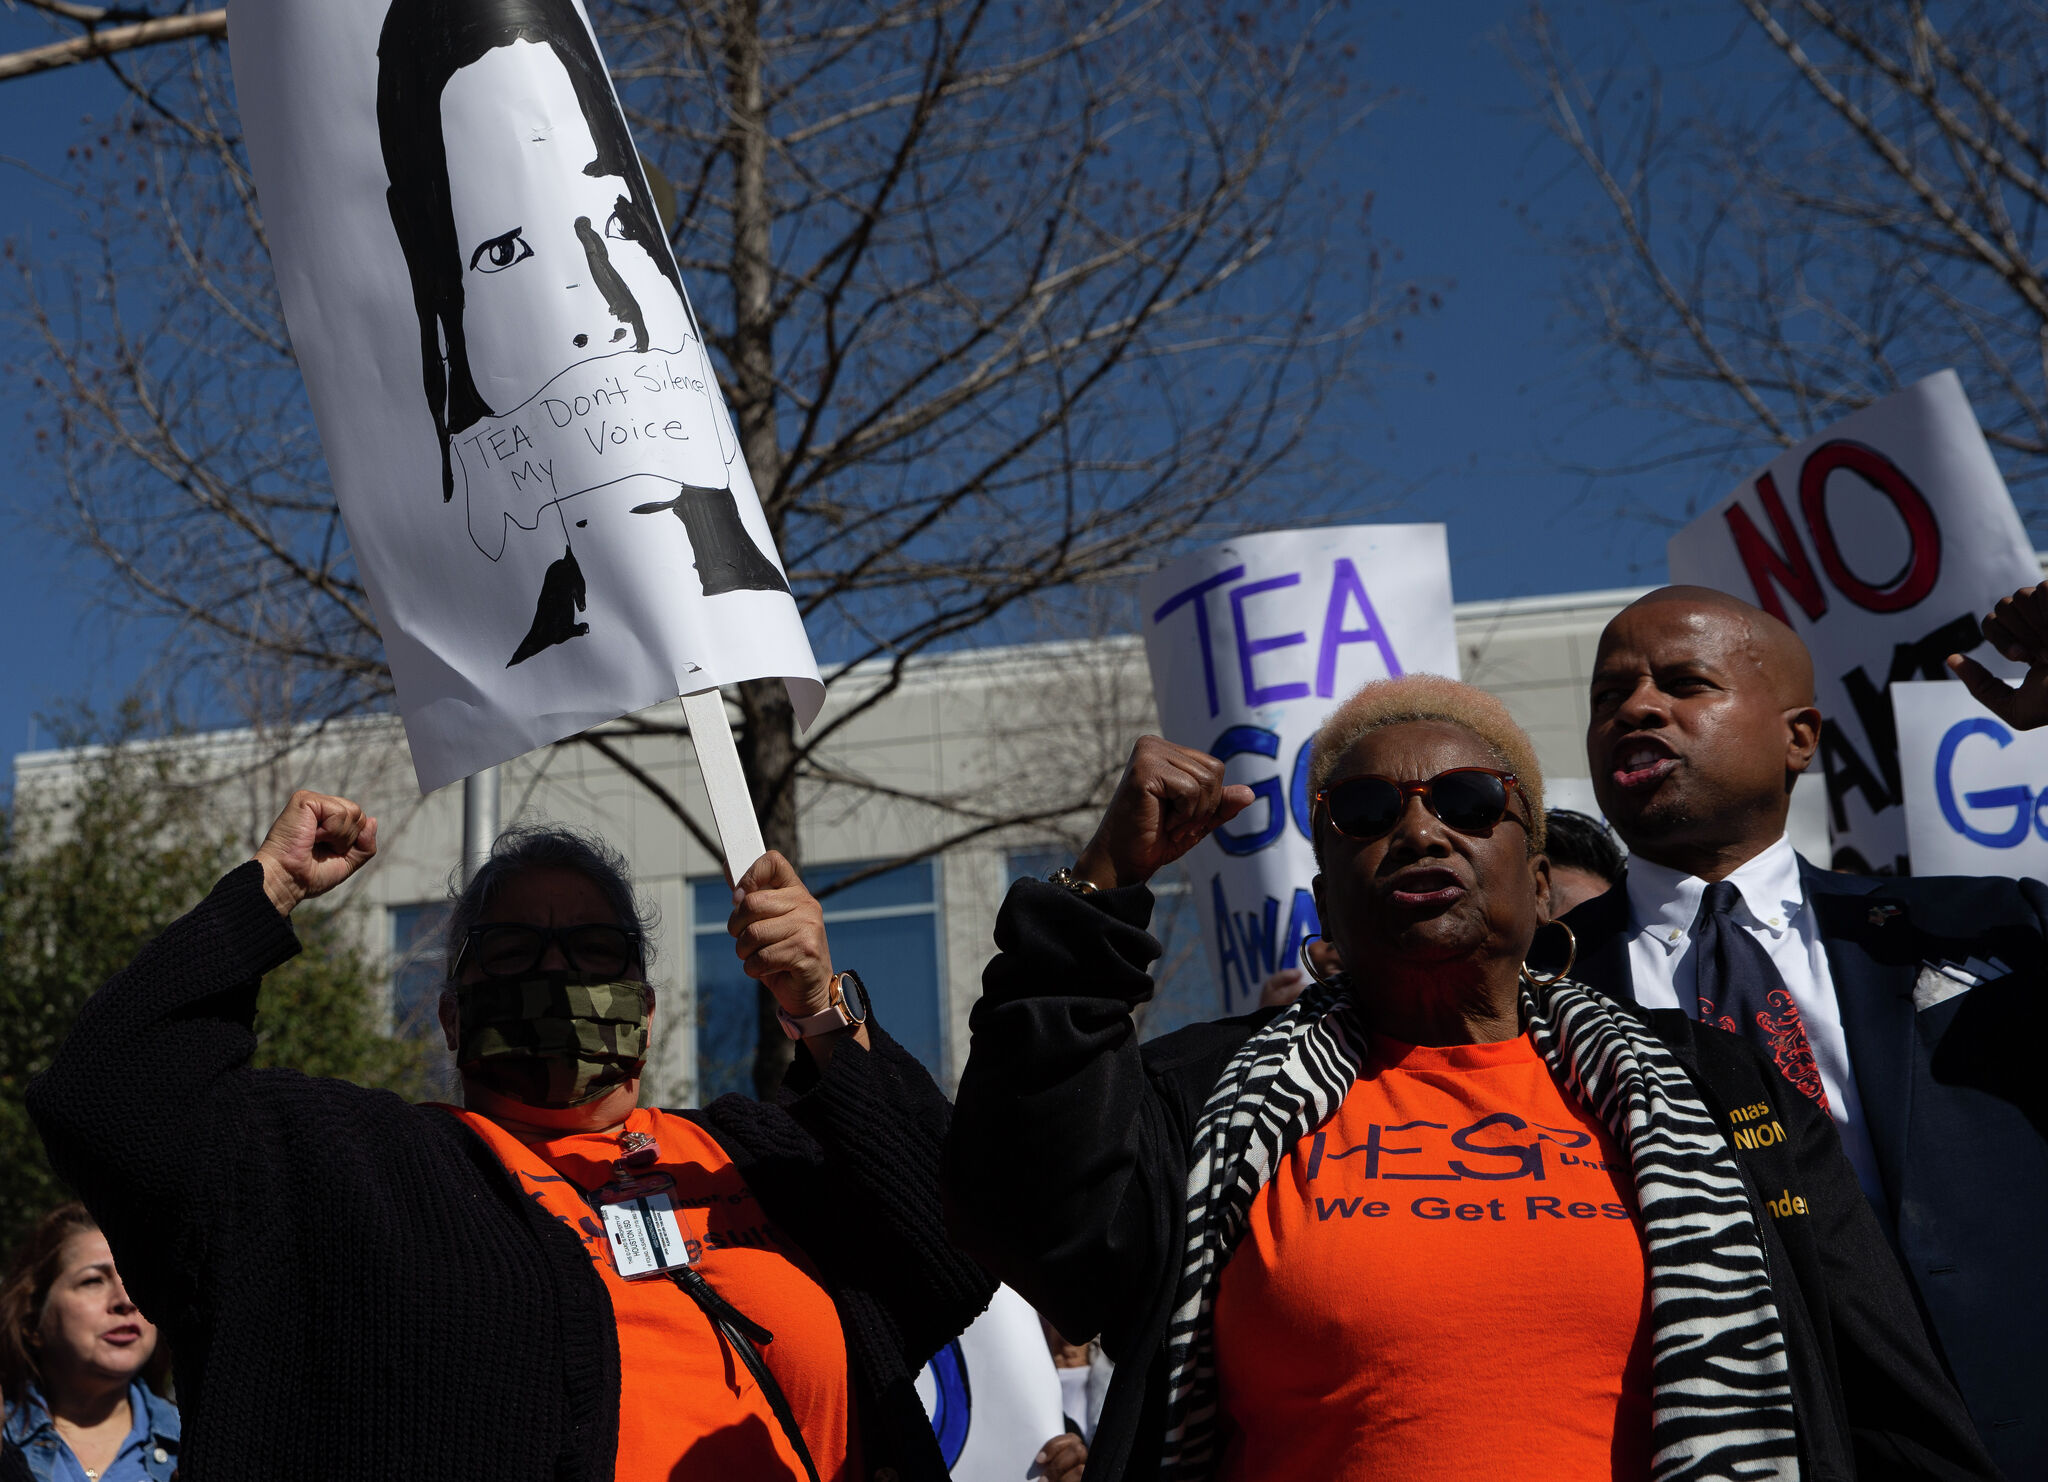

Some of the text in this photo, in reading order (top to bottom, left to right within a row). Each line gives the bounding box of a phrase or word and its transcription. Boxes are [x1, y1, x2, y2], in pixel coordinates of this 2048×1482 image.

[463, 360, 706, 468] TEA Don't Silence
[584, 418, 689, 455] Voice
[1723, 438, 1942, 630] NO
[1154, 557, 1405, 719] TEA
[1935, 717, 2048, 850] G
[623, 1220, 632, 1229] ISD
[626, 1230, 640, 1256] HOUSTON
[1314, 1195, 1390, 1222] We
[1410, 1196, 1507, 1222] Get
